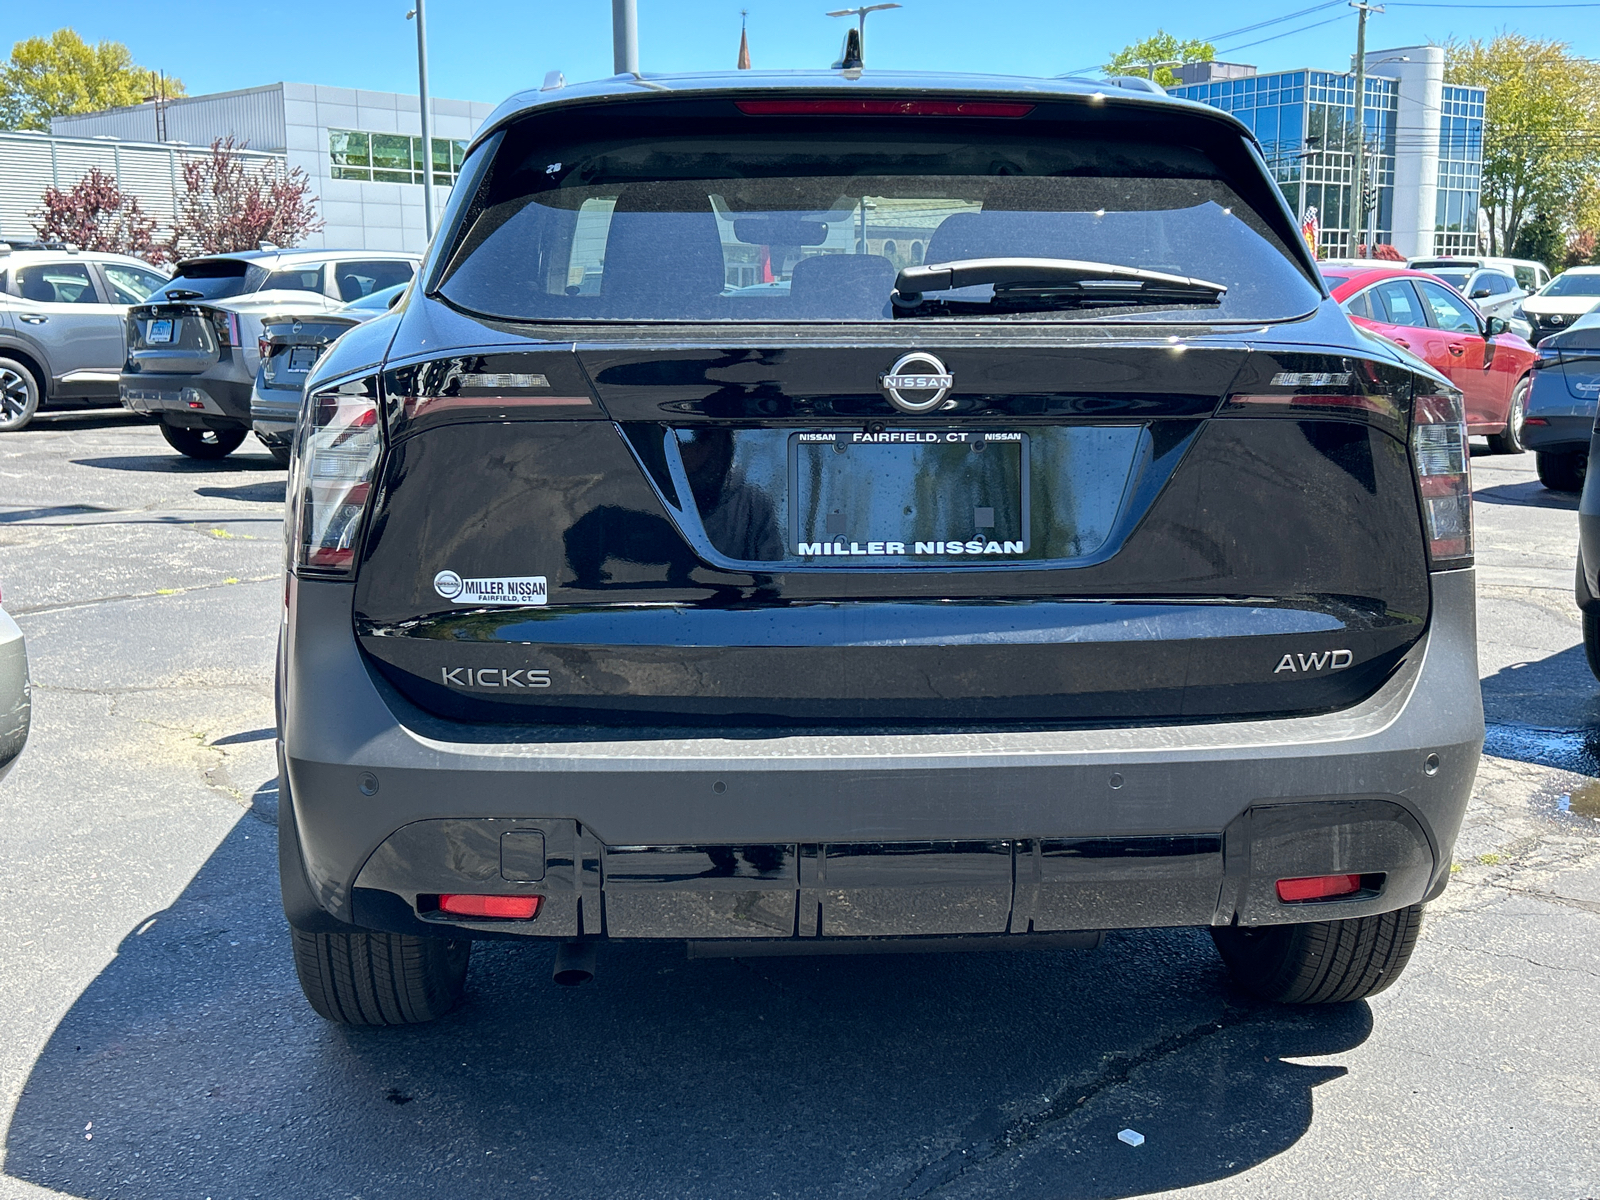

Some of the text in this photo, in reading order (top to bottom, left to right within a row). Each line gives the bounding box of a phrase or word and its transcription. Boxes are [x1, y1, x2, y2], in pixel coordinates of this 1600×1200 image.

[885, 377, 951, 388] NISSAN
[799, 433, 836, 441] NISSAN
[853, 433, 968, 443] FAIRFIELD, CT
[984, 432, 1021, 440] NISSAN
[798, 541, 1024, 555] MILLER NISSAN
[465, 581, 546, 595] MILLER NISSAN
[1273, 649, 1353, 673] AWD
[442, 667, 551, 688] KICKS
